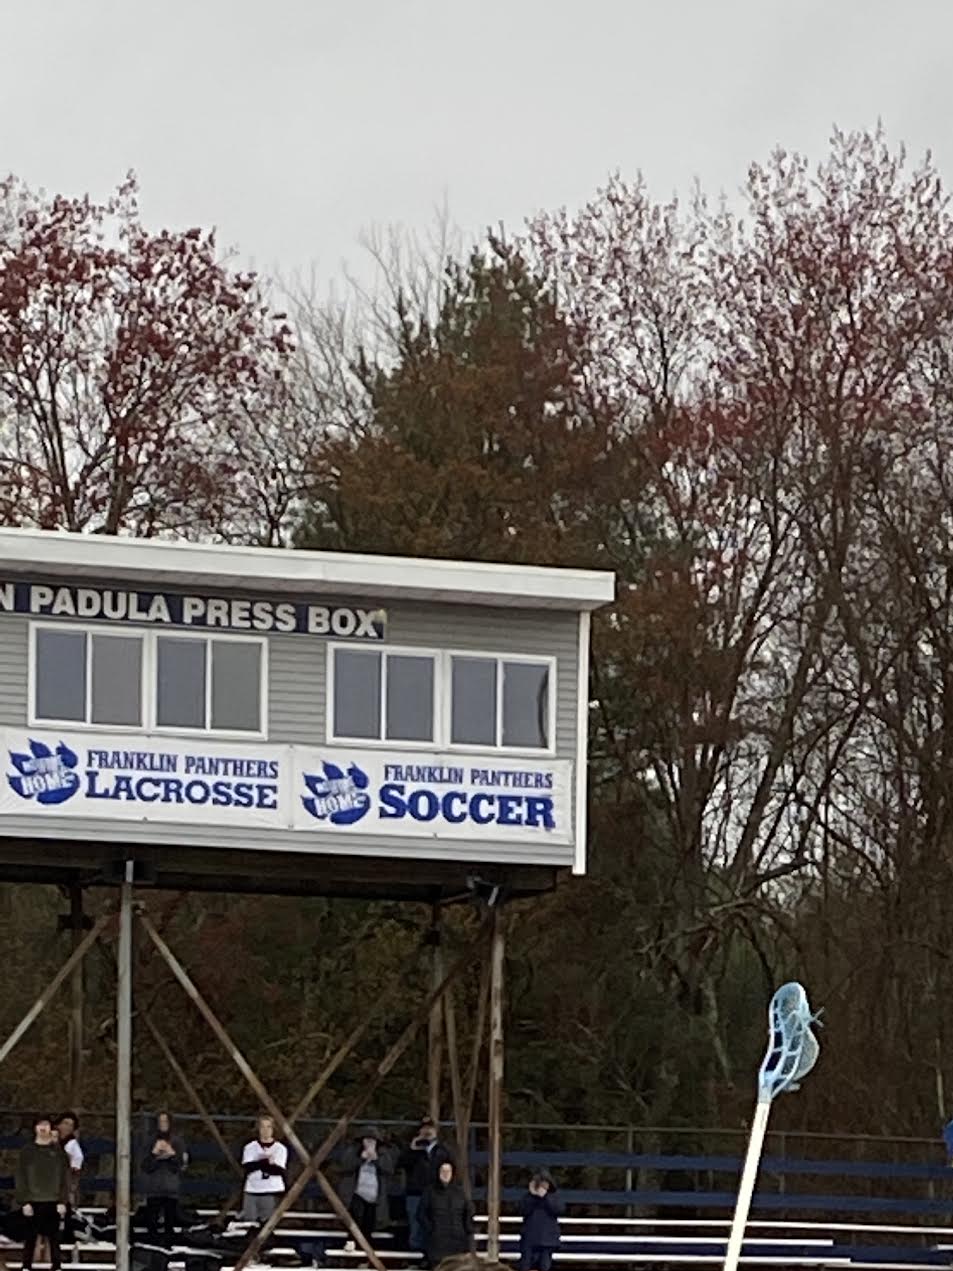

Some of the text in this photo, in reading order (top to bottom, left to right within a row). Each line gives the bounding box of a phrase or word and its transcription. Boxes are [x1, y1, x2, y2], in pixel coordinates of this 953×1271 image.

[30, 584, 172, 623] PADULA
[182, 596, 297, 632] PRESS
[307, 605, 378, 637] BOX
[86, 749, 179, 773] FRANKLIN
[184, 755, 279, 779] PANTHERS
[384, 764, 553, 789] FRANKLIN PANTHERS
[84, 770, 278, 810] LACROSSE
[378, 783, 556, 830] SOCCER
